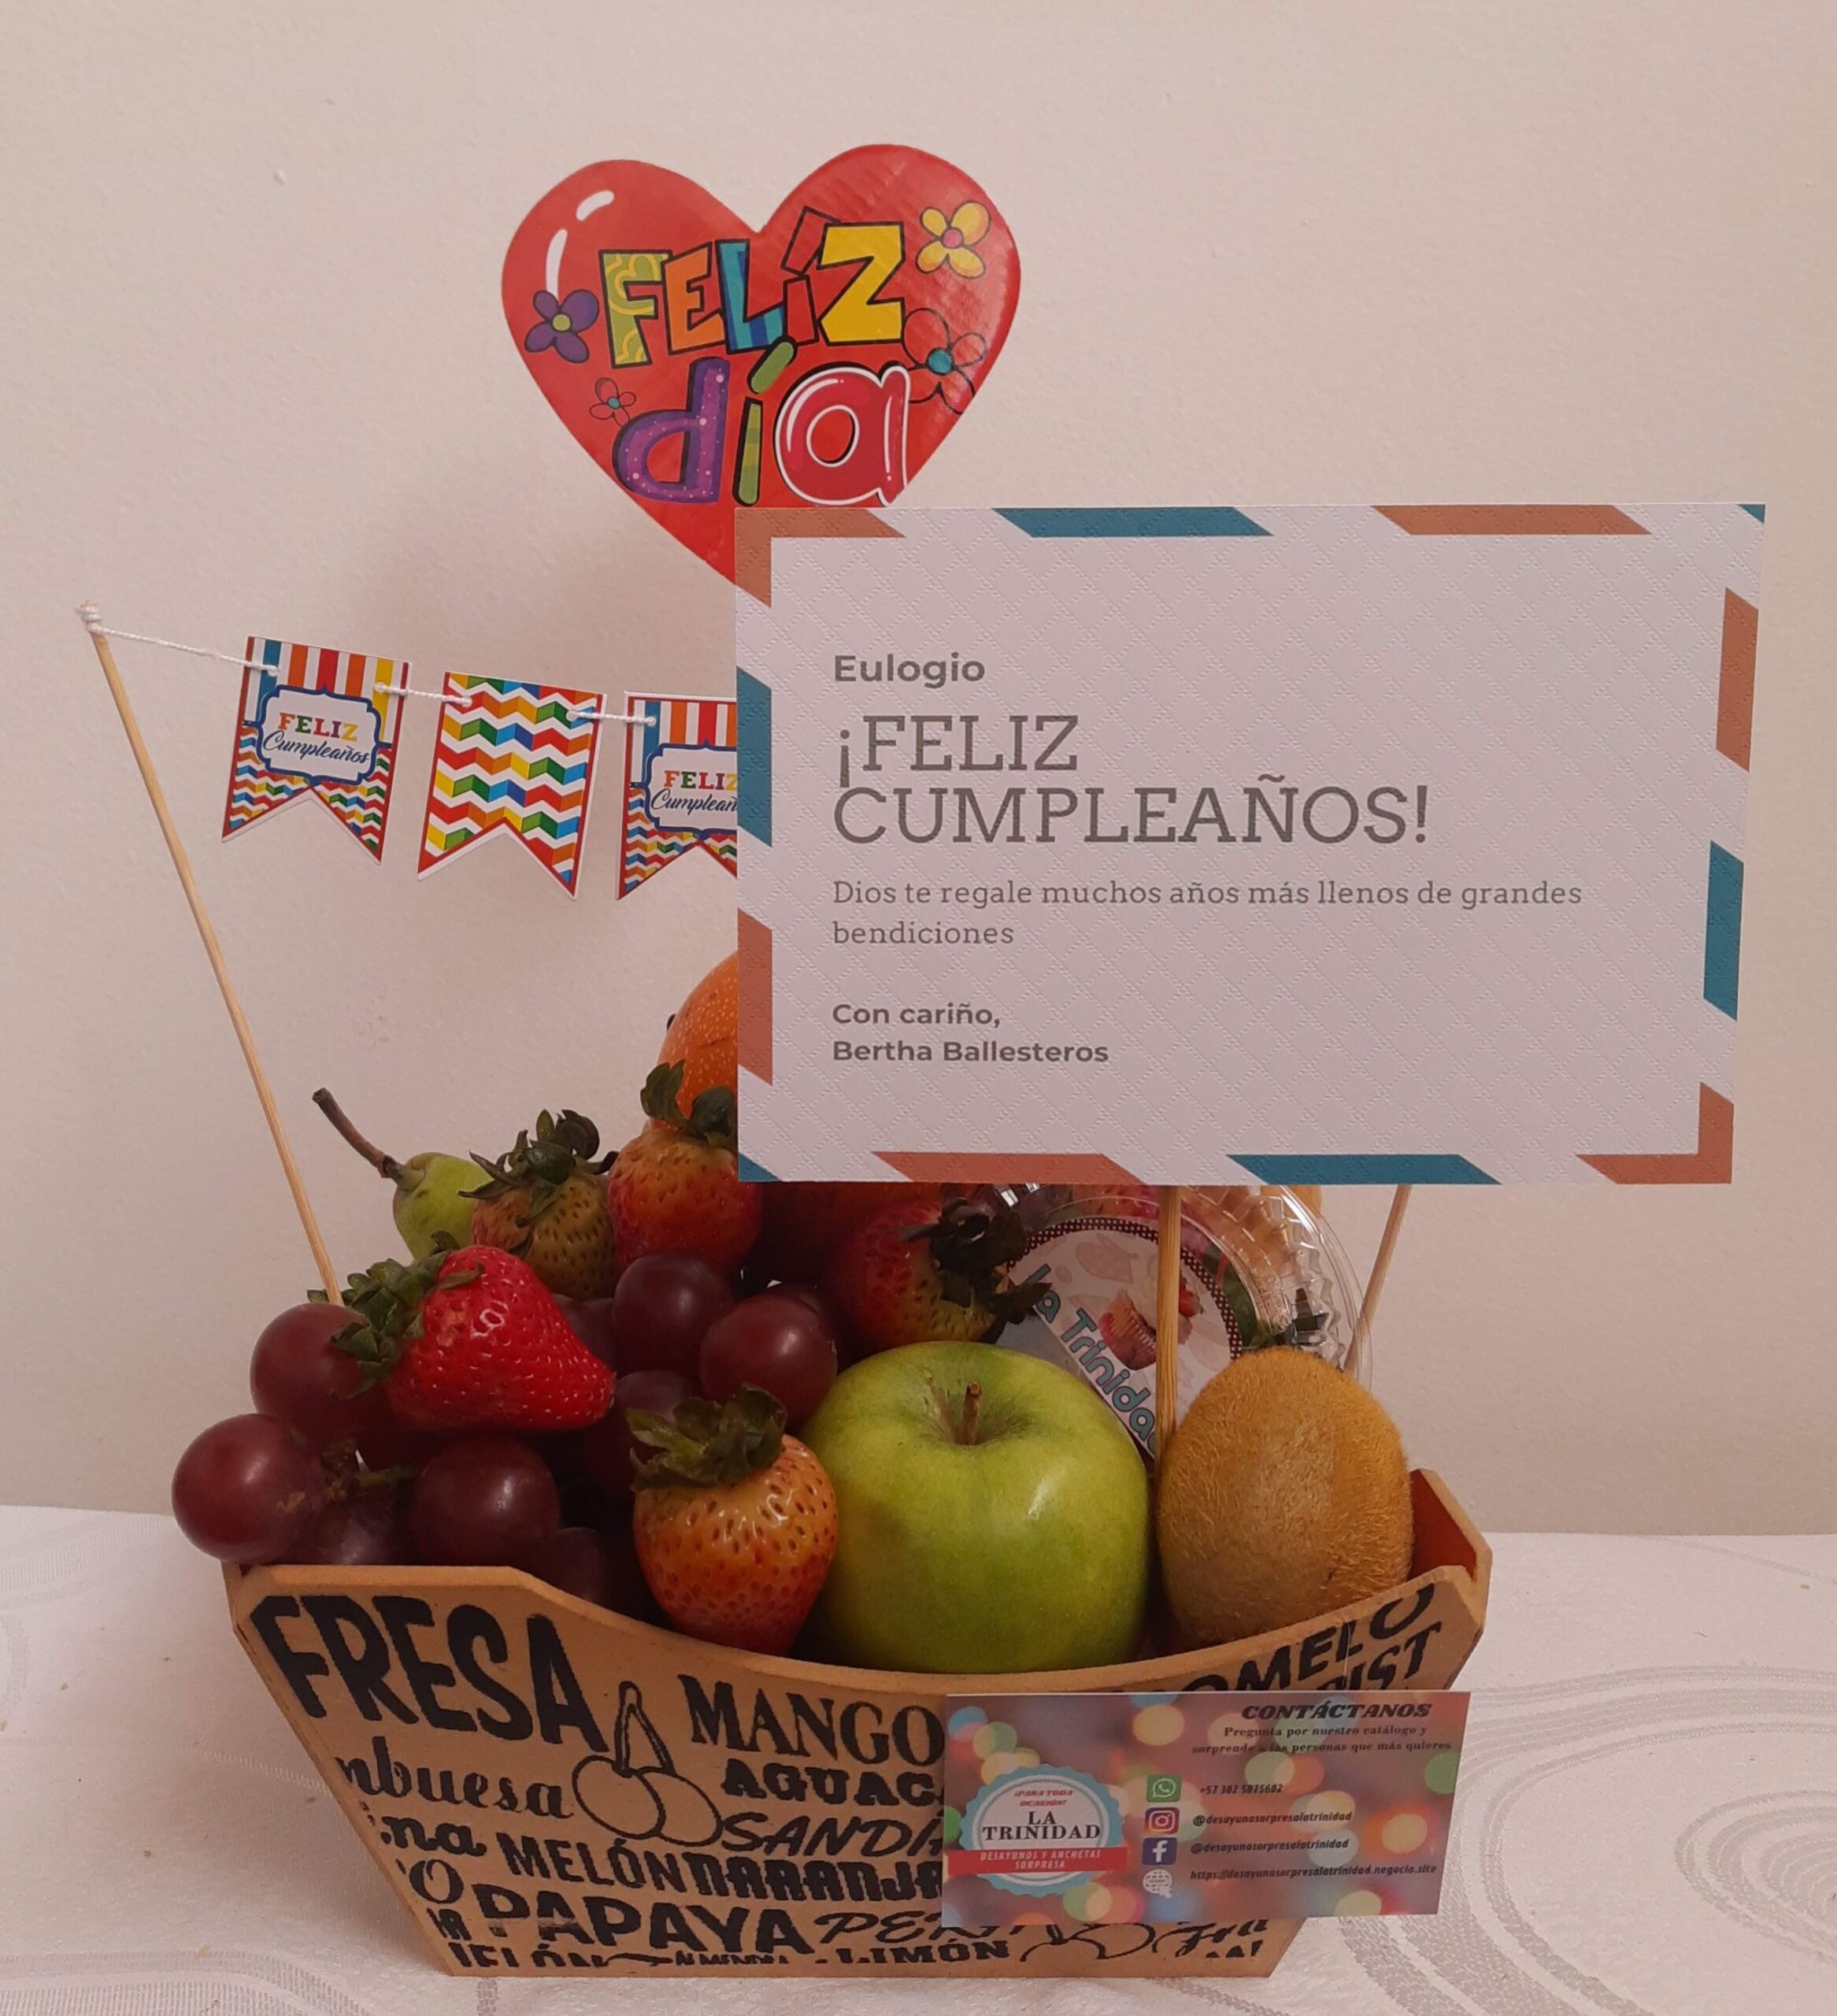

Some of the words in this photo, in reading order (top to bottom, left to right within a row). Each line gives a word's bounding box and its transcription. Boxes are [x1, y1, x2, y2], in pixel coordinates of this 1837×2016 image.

[834, 651, 985, 689] Eulogio
[278, 712, 360, 742] FELIZ
[263, 730, 369, 764] Cumpleaños
[839, 715, 1079, 788] ¡FELIZ
[650, 788, 737, 816] Cumpleañ
[835, 773, 1428, 844] CUMPLEAÑOS!
[833, 880, 896, 904] Dios
[905, 882, 931, 904] te
[941, 880, 1032, 909] regale
[1042, 880, 1161, 904] muchos
[1169, 882, 1239, 904] años
[1248, 882, 1309, 904] más
[1318, 880, 1409, 904] llenos
[1417, 880, 1451, 904] de
[1461, 881, 1582, 910] grandes
[833, 921, 1014, 944] bendiciones
[832, 1004, 890, 1025] Con
[899, 1003, 1000, 1028] cariño,
[833, 1041, 932, 1061] Bertha
[943, 1041, 1109, 1062] Ballesteros
[1061, 1307, 1156, 1455] Trinida
[250, 1595, 609, 1752] FRESA
[676, 1674, 945, 1766] MANGO
[1242, 1701, 1431, 1720] CONTÁCTANOS
[1224, 1726, 1282, 1738] Pregunta
[1287, 1727, 1308, 1738] por
[1312, 1725, 1359, 1736] nuestro
[1363, 1725, 1417, 1736] catálogo
[1420, 1726, 1428, 1736] y
[1191, 1744, 1256, 1755] sorprende
[1292, 1744, 1348, 1756] personas
[1351, 1744, 1372, 1753] que
[1377, 1741, 1402, 1751] más
[1406, 1742, 1452, 1751] quieres
[721, 1758, 943, 1807] AGUAC
[983, 1825, 1101, 1840] TRINIDAD
[1028, 1810, 1057, 1825] LA
[496, 1832, 687, 1892] MELÓN
[980, 1851, 1038, 1861] DESAYUNOS
[1050, 1850, 1101, 1859] ANCHETAS
[1014, 1861, 1065, 1870] SORPRESA
[471, 1884, 815, 1955] PAPAYA
